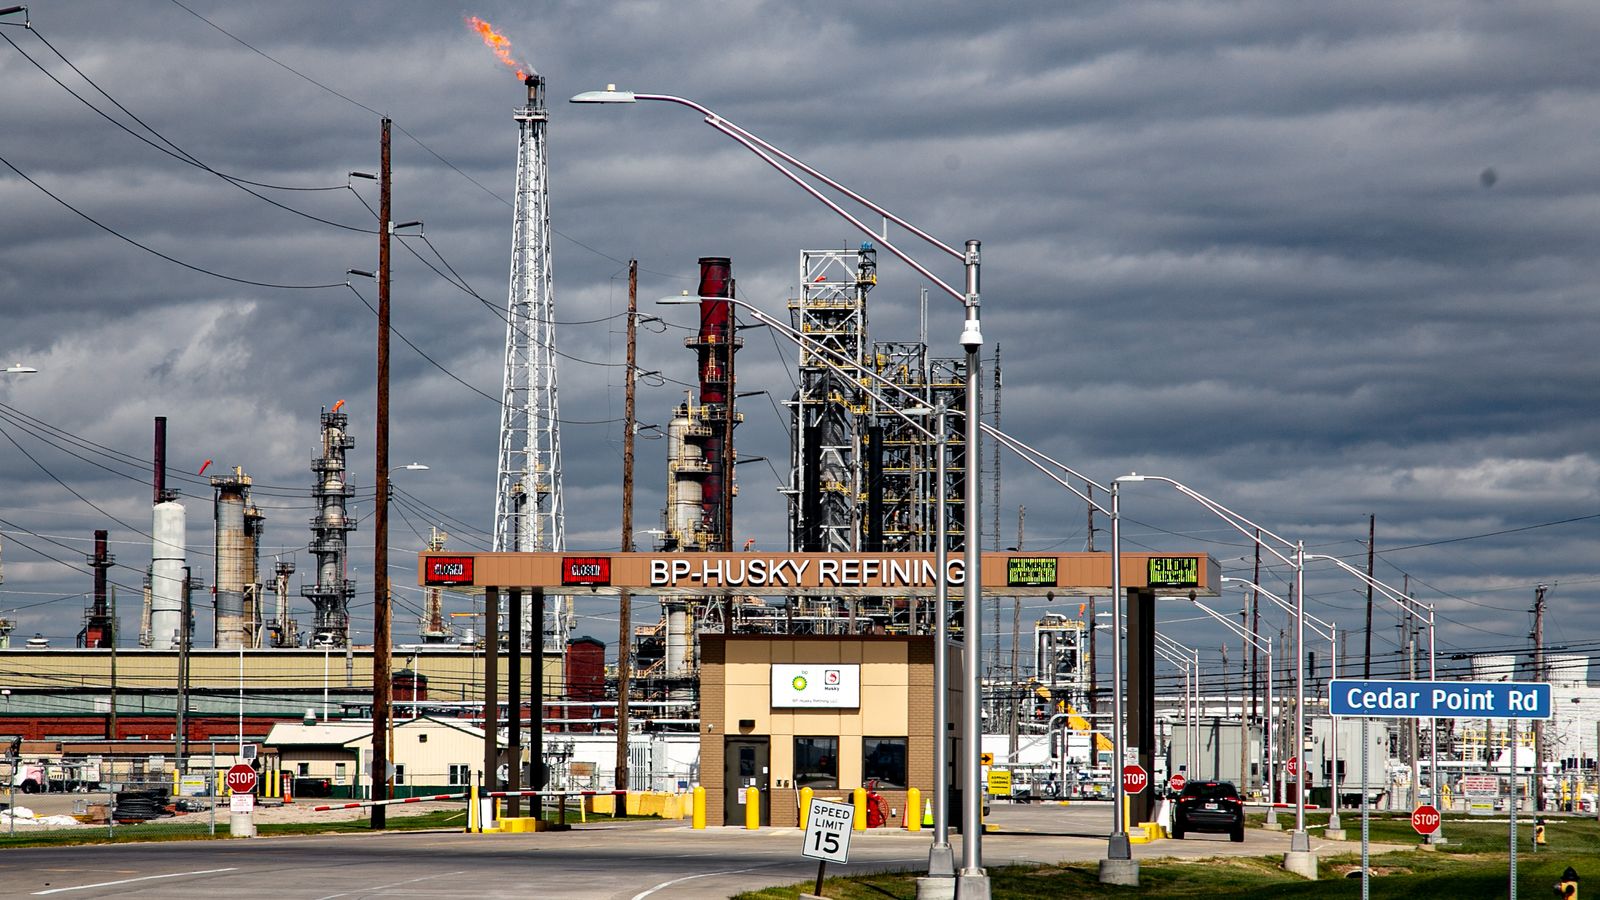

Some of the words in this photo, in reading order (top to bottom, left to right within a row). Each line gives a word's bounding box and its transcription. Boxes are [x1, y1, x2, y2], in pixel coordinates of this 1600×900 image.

[434, 563, 463, 575] CLOSED
[571, 564, 600, 576] CLOSED
[1154, 558, 1192, 571] SLOW
[650, 559, 810, 585] BP-HUSKY
[818, 559, 966, 585] REFINING
[1347, 687, 1420, 709] Cedar
[1432, 688, 1495, 710] Point
[1508, 689, 1538, 711] Rd
[229, 772, 255, 784] STOP
[813, 805, 850, 820] SPEED
[815, 818, 845, 831] LIMIT
[1414, 814, 1439, 825] STOP
[814, 830, 840, 854] 15
